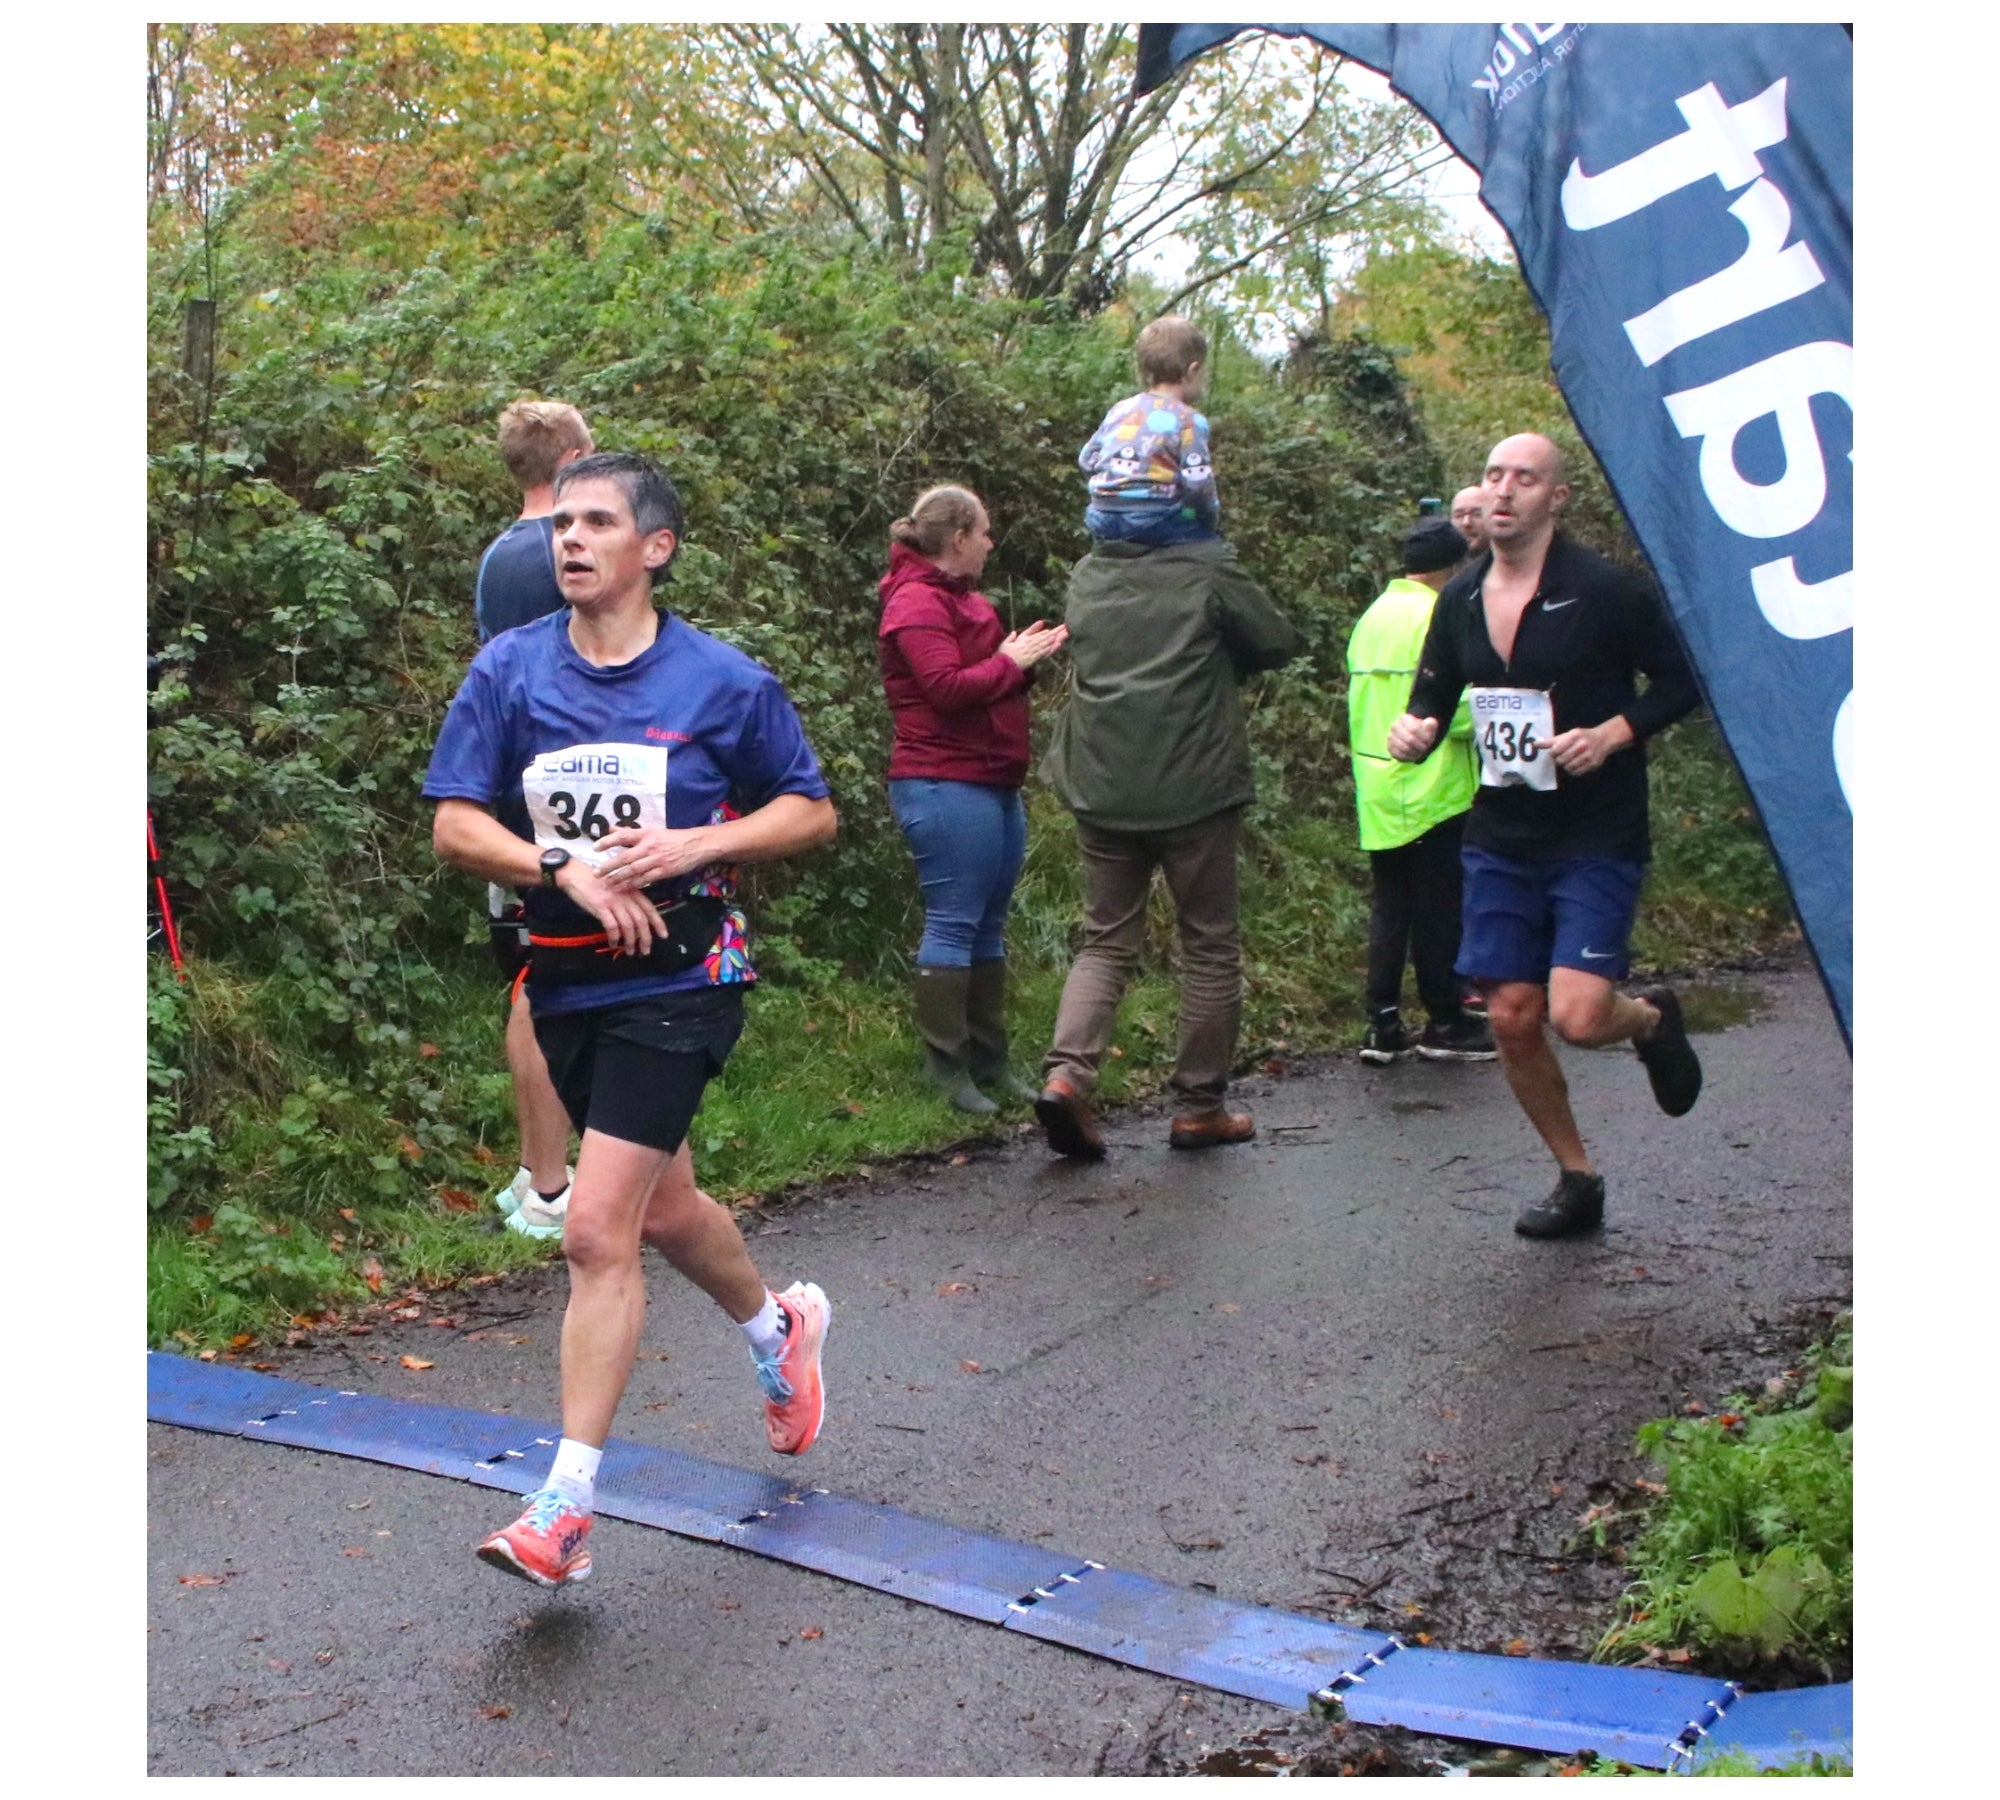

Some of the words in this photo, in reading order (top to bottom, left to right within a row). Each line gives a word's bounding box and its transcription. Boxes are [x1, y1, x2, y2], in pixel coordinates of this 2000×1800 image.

[1475, 695, 1522, 710] eama
[1484, 721, 1538, 762] 436
[548, 791, 642, 848] 368
